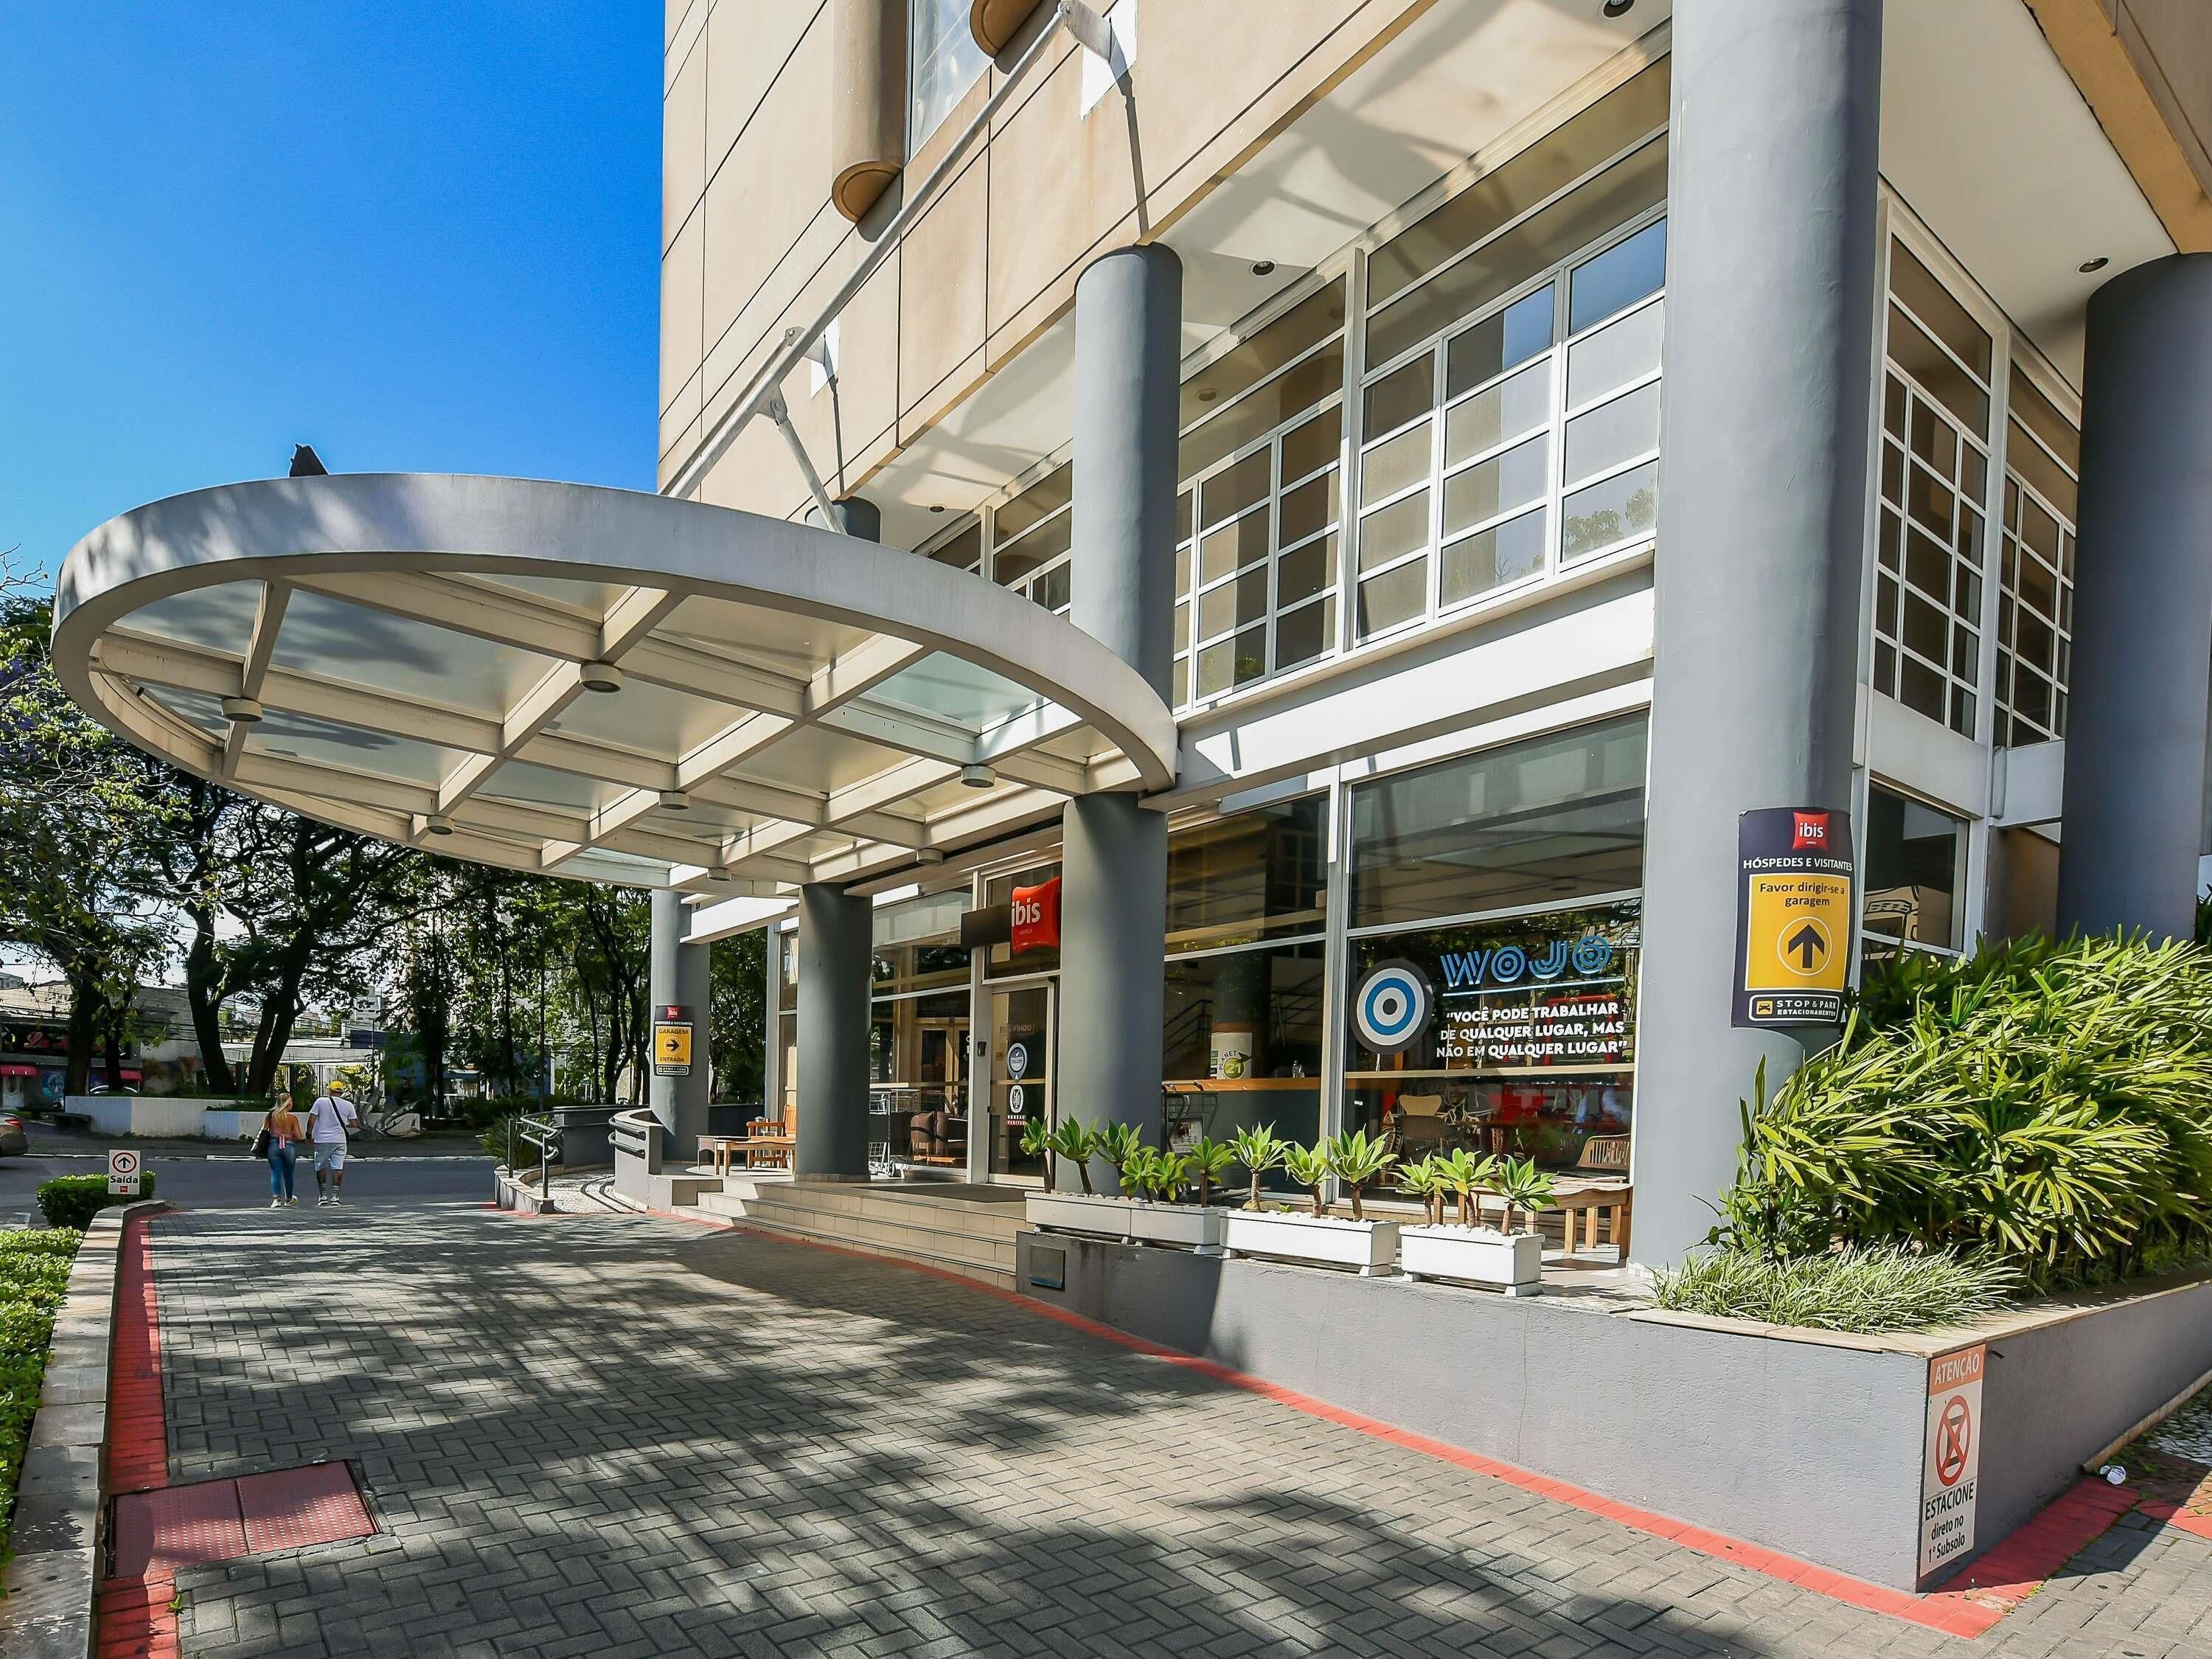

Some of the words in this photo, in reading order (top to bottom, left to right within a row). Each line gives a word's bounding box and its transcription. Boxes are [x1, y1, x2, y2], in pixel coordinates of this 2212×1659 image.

[1799, 822, 1823, 838] ibis
[1743, 857, 1803, 869] HÓSPEDES
[1806, 858, 1812, 867] E
[1814, 858, 1853, 872] VISITANTES
[1760, 883, 1794, 893] Favor
[1798, 882, 1839, 894] dirigir-se
[1840, 886, 1845, 894] a
[1011, 897, 1041, 927] ibis
[1784, 896, 1830, 908] garagem
[1440, 936, 1611, 987] WOJO
[1447, 1006, 1489, 1023] "VOCÊ
[1492, 1008, 1529, 1020] PODE
[1532, 1002, 1618, 1019] TRABALHAR
[1776, 1000, 1810, 1008] STOP
[1819, 1001, 1837, 1009] PARK
[1440, 1030, 1456, 1041] DE
[1459, 1025, 1533, 1043] QUALQUER
[1535, 1023, 1588, 1037] LUGAR,
[1593, 1021, 1624, 1034] MAS
[1436, 1044, 1464, 1058] NÃO
[1467, 1046, 1485, 1057] EM
[1487, 1043, 1565, 1058] QUALQUER
[1567, 1040, 1628, 1054] LUGAR"
[1219, 1050, 1237, 1070] PLANET
[1226, 1063, 1241, 1074] 21
[111, 1175, 138, 1183] Saída
[1934, 1352, 1980, 1386] ATENÇÃO
[1924, 1481, 1975, 1522] ESTACIONE
[1930, 1520, 1953, 1541] direto
[1954, 1514, 1964, 1529] no
[1936, 1532, 1966, 1560] Subsolo
